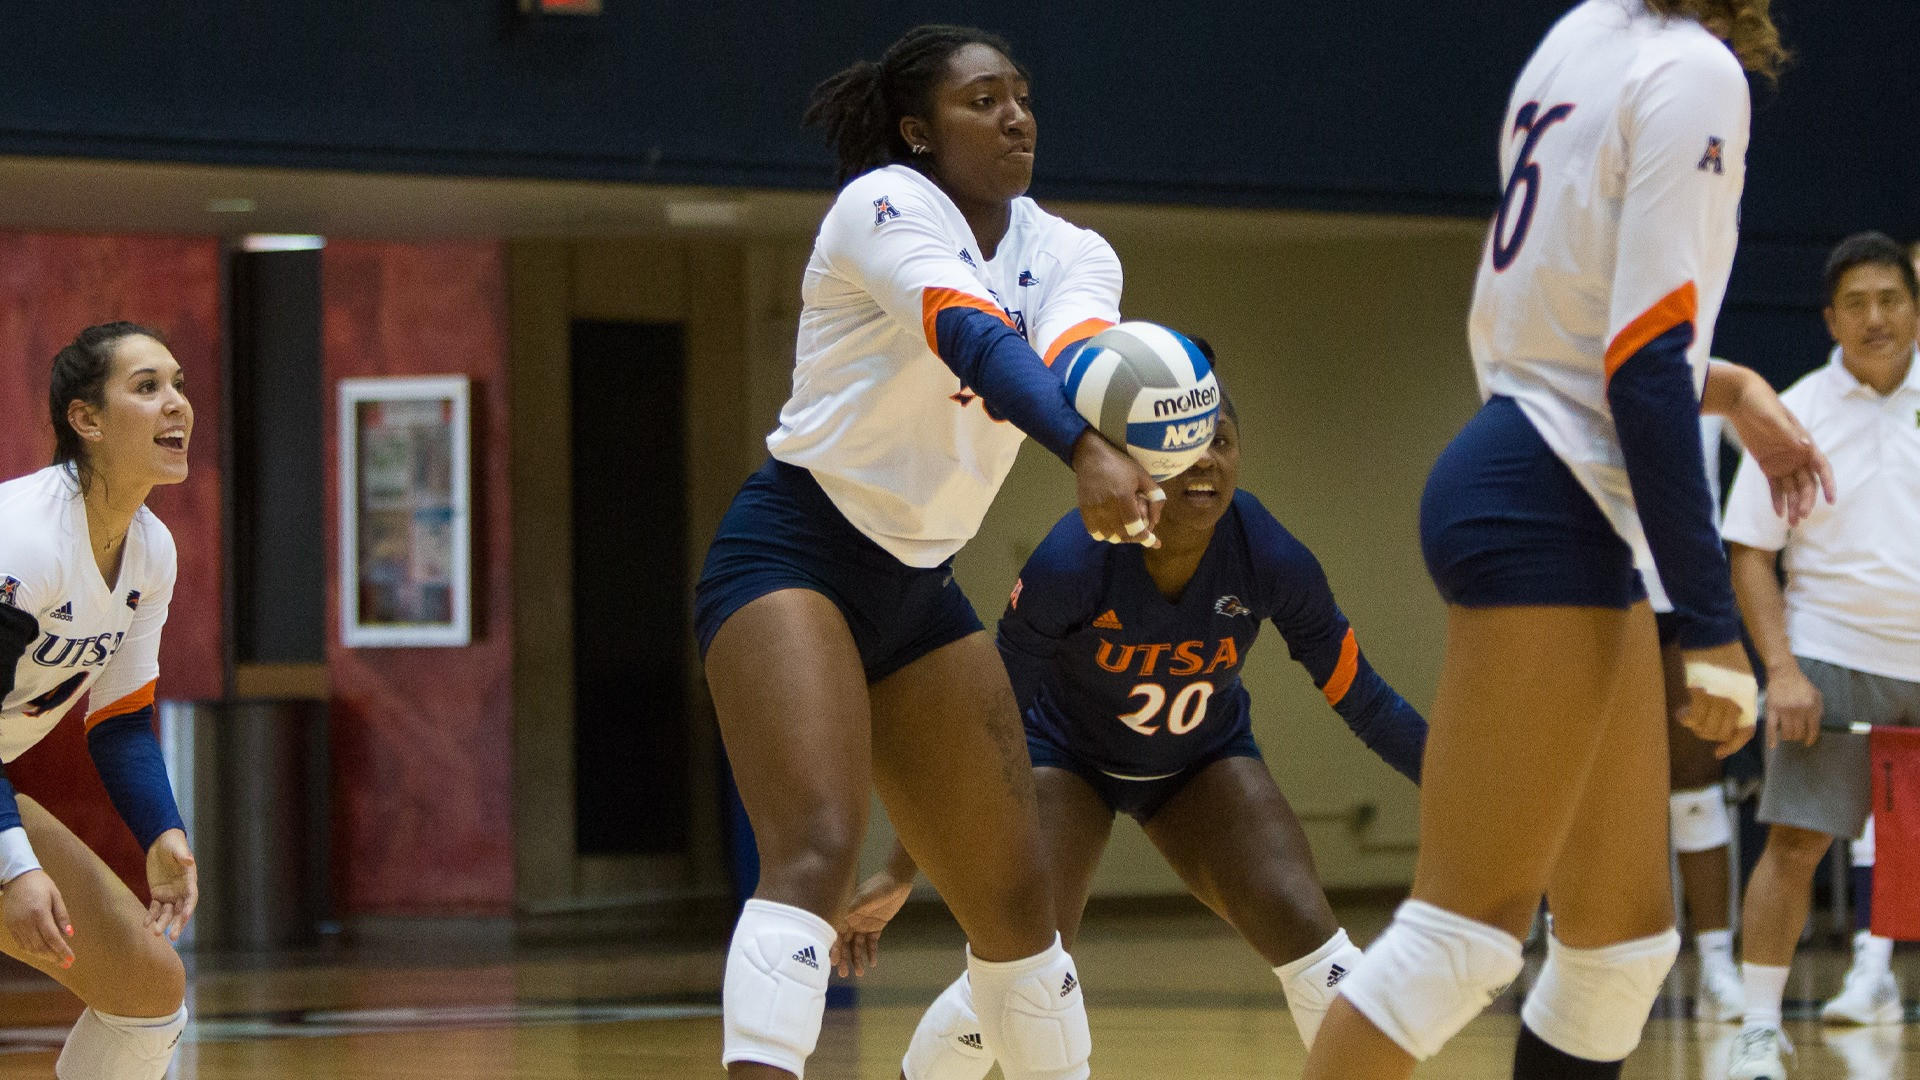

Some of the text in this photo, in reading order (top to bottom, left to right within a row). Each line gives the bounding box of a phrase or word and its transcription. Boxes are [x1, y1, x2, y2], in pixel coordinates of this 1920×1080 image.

[1493, 101, 1576, 273] 6
[1154, 387, 1217, 417] molten
[1095, 637, 1239, 676] UTSA
[1117, 678, 1214, 736] 20
[792, 954, 819, 970] adidas
[958, 1036, 983, 1050] adidas
